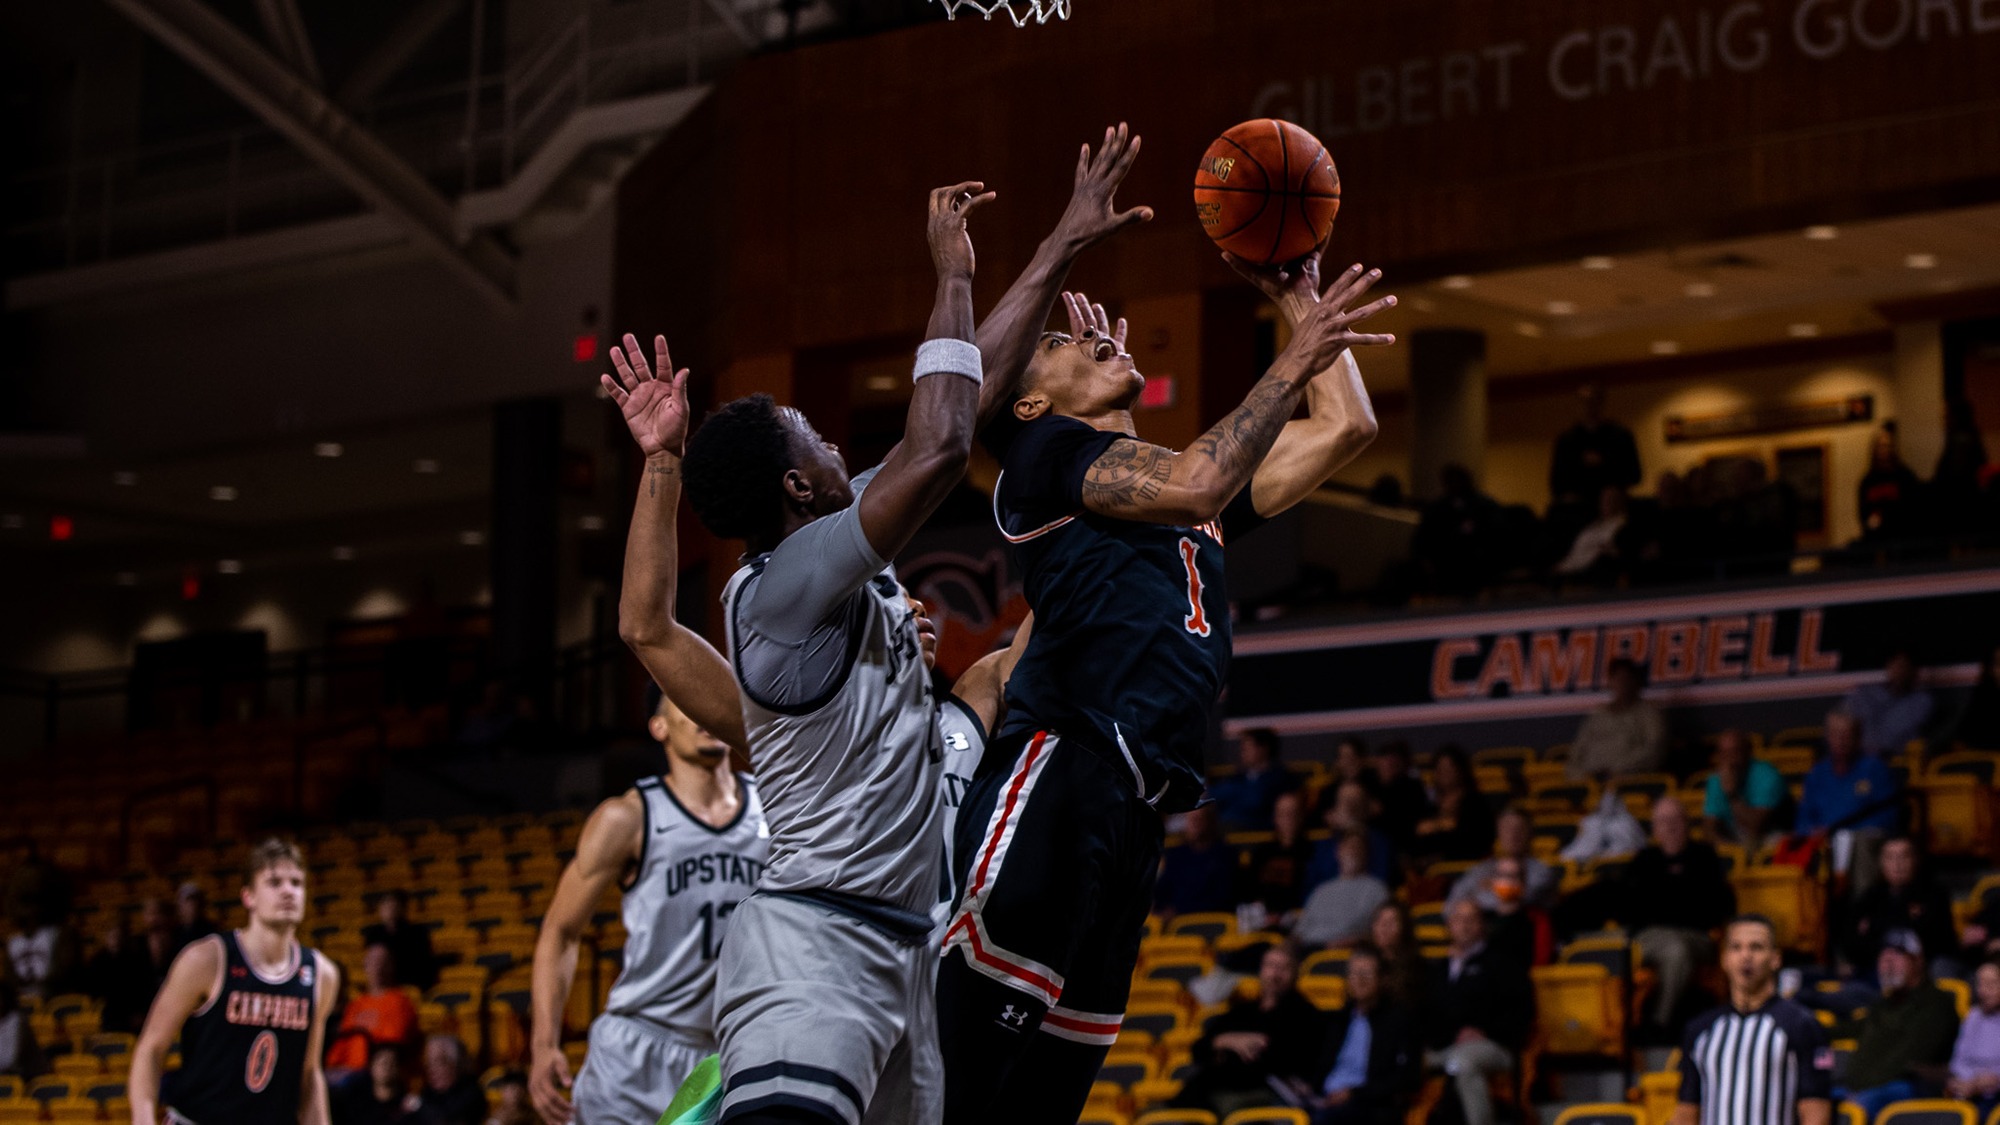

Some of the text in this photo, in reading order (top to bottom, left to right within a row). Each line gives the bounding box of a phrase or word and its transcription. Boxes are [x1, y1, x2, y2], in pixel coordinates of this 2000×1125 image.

[1249, 41, 1528, 138] GILBERT
[1547, 0, 1772, 100] CRAIG
[1178, 536, 1211, 638] 1
[1429, 608, 1843, 699] CAMPBELL
[244, 1029, 279, 1094] 0
